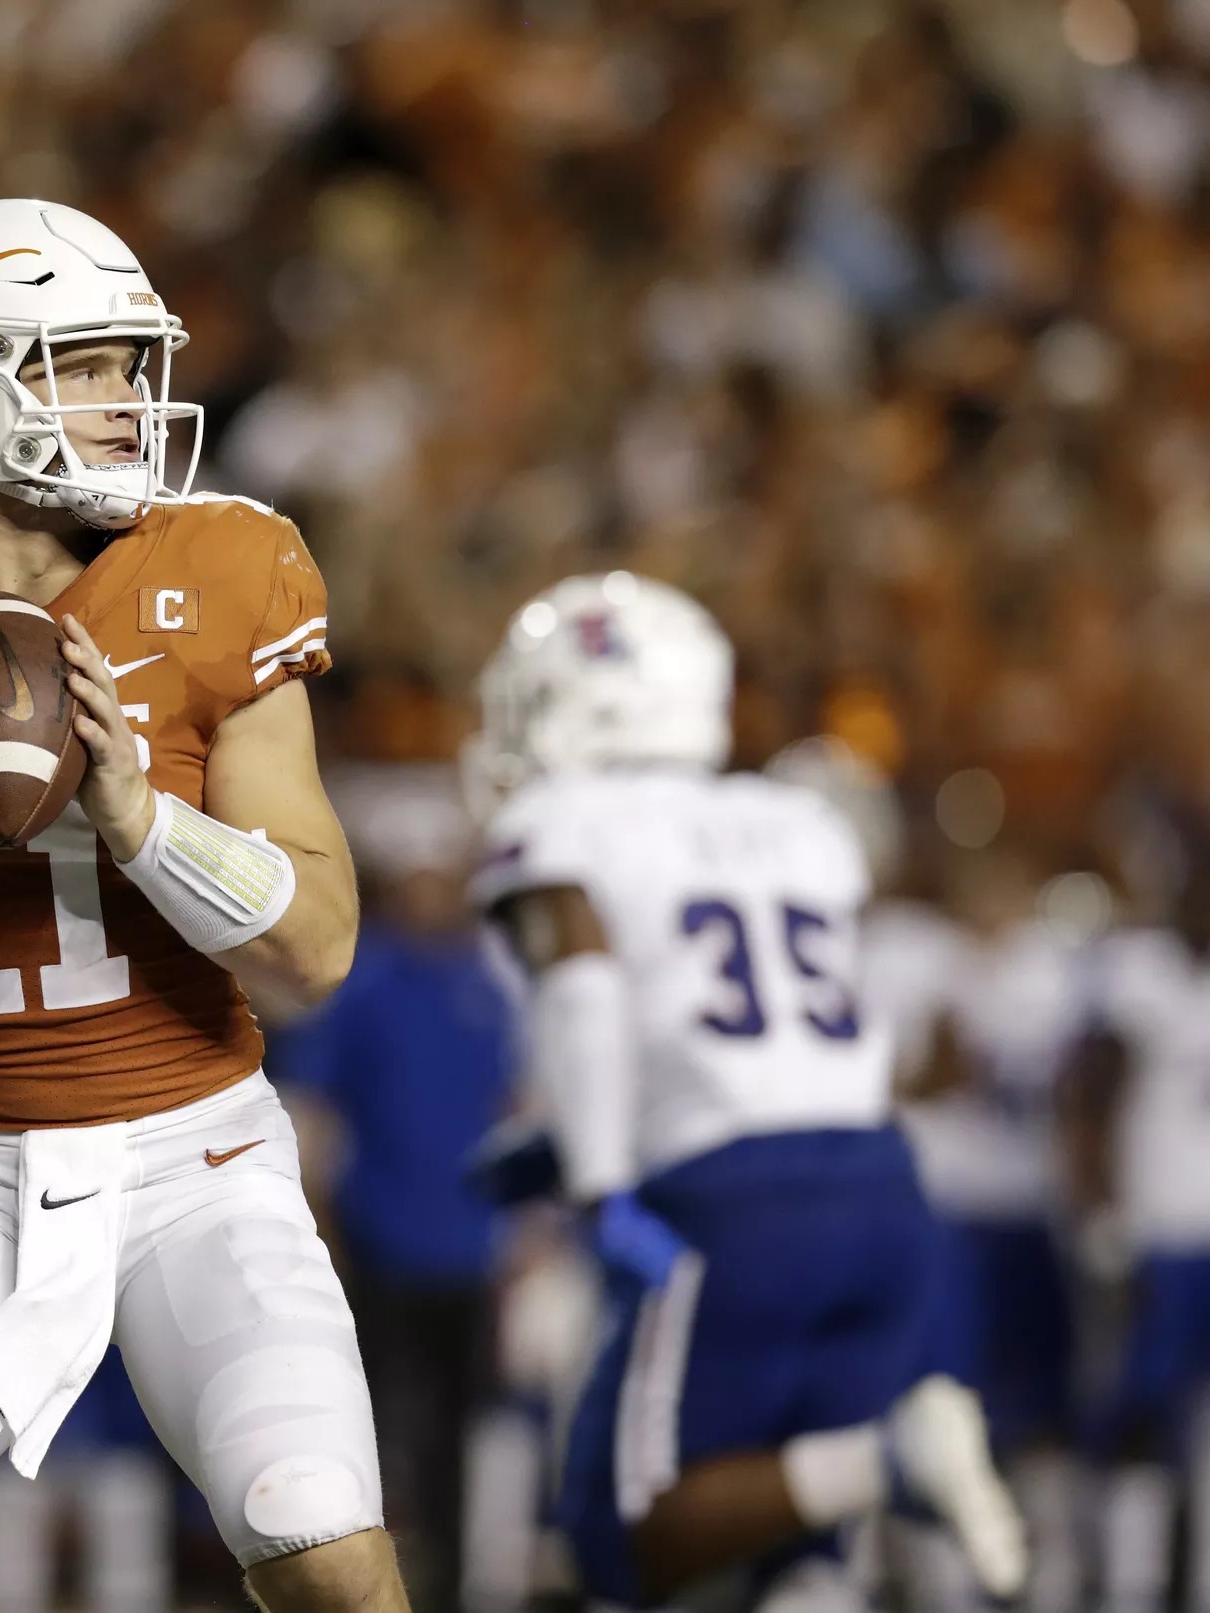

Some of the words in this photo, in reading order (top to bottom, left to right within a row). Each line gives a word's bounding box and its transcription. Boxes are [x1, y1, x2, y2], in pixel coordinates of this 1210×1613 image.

[127, 292, 158, 307] HORNS
[156, 589, 184, 629] C
[682, 898, 860, 1040] 35
